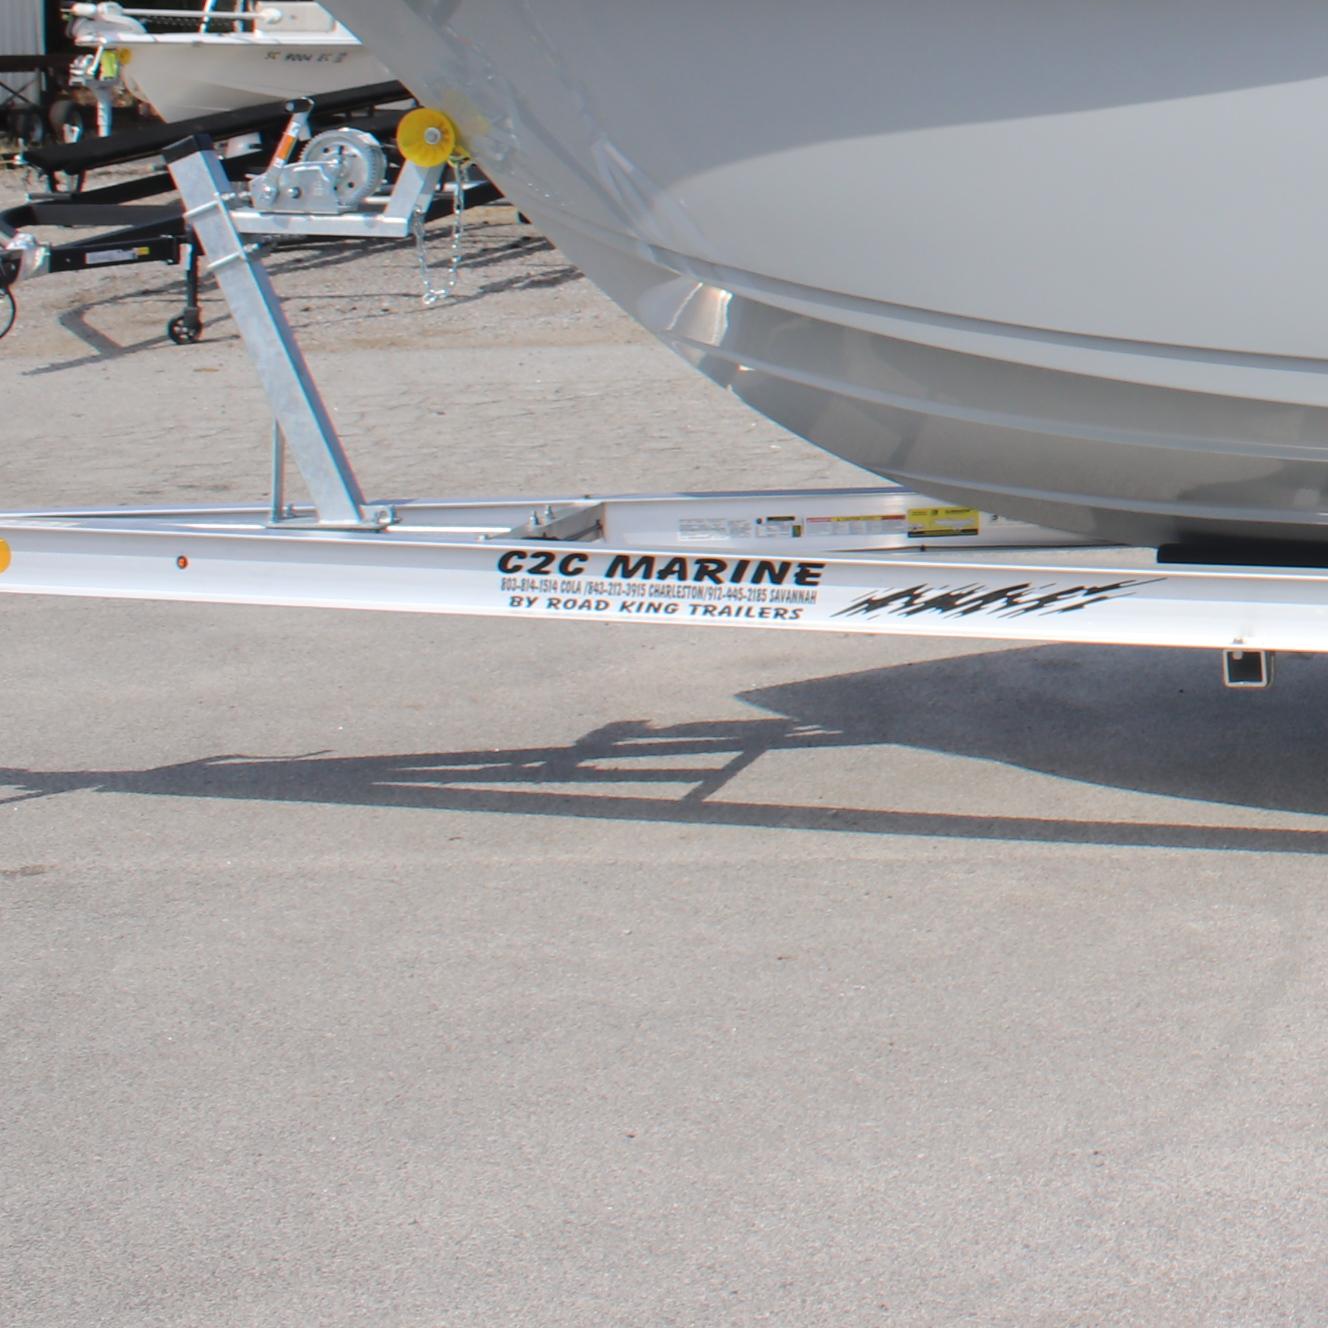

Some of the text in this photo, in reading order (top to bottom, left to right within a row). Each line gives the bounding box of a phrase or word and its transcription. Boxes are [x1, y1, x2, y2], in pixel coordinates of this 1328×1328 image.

[497, 550, 826, 587] C2C MARINE
[509, 596, 804, 621] BY ROAD KING TRAILERS
[768, 589, 818, 604] SAVANNAH
